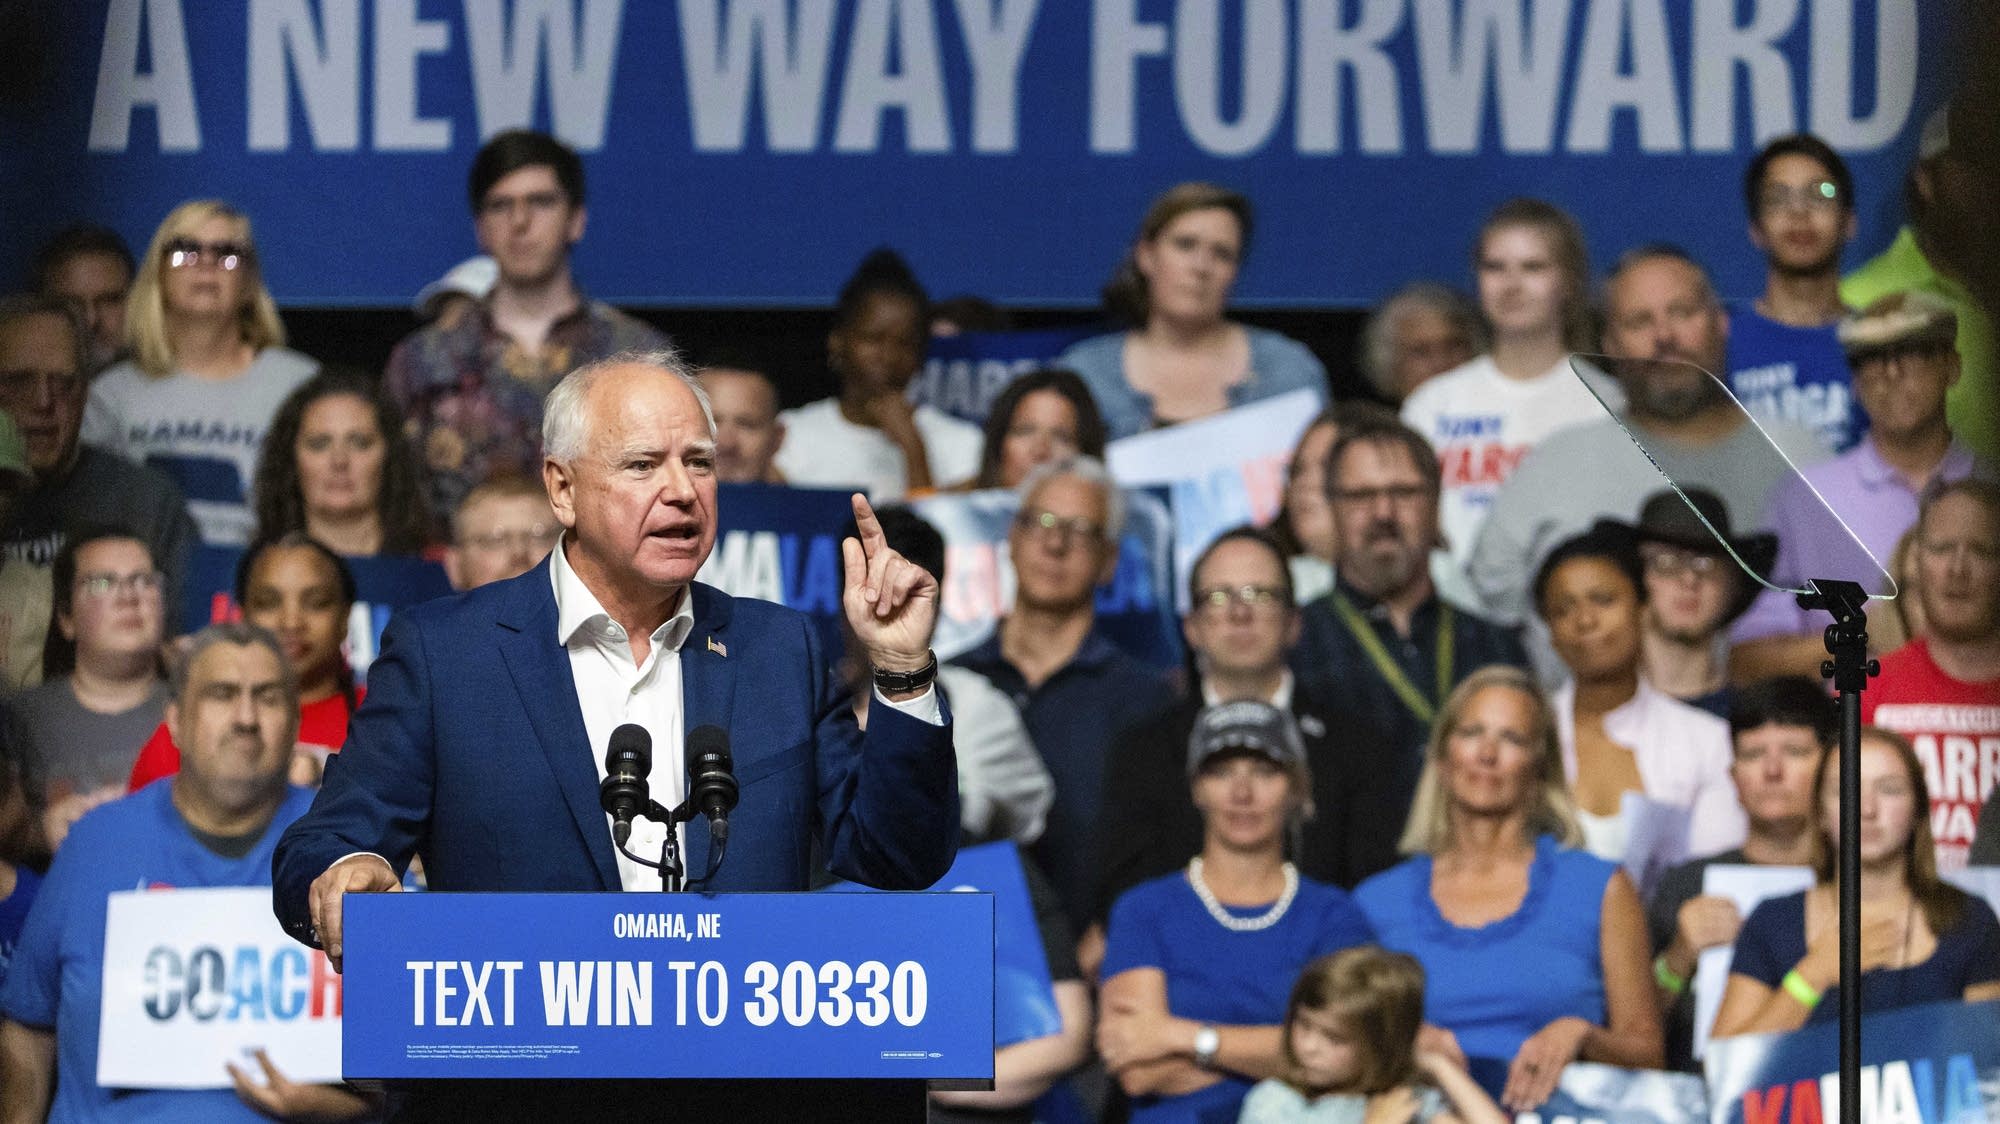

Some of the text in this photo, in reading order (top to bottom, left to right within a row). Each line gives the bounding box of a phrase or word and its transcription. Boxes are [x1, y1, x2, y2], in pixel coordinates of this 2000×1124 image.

[88, 0, 1919, 156] A NEW WAY FORWARD
[613, 913, 721, 942] OMAHA, NE
[144, 946, 341, 1021] COACH
[406, 960, 928, 1027] TEXT WIN TO 30330
